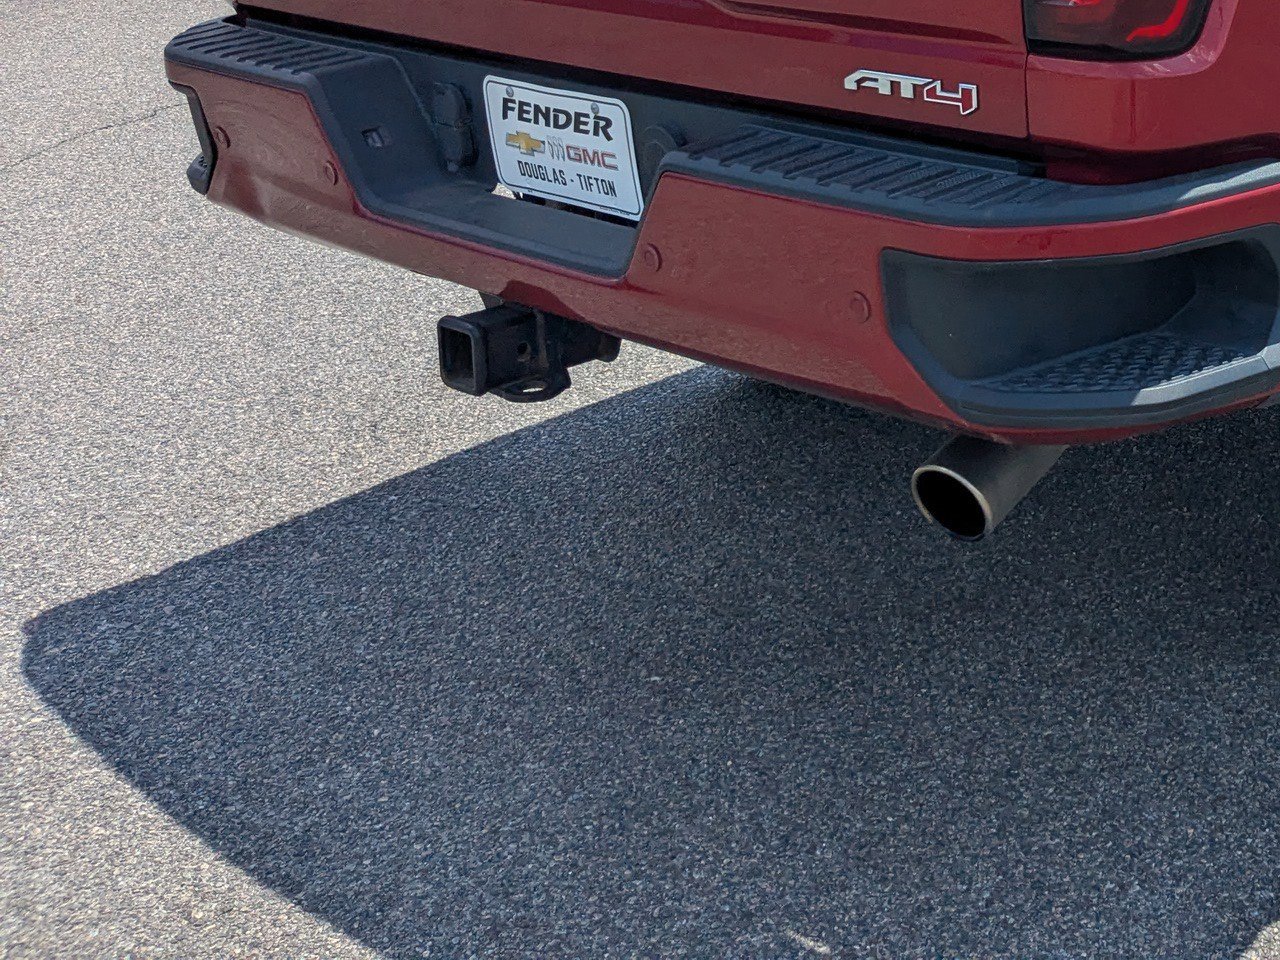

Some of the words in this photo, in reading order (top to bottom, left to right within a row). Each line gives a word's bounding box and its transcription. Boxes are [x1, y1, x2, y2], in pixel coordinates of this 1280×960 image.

[844, 69, 977, 115] AT4
[502, 97, 613, 142] FENDER
[566, 144, 619, 171] GMC
[517, 160, 567, 186] DOUGLAS
[577, 173, 617, 198] TIFTON
